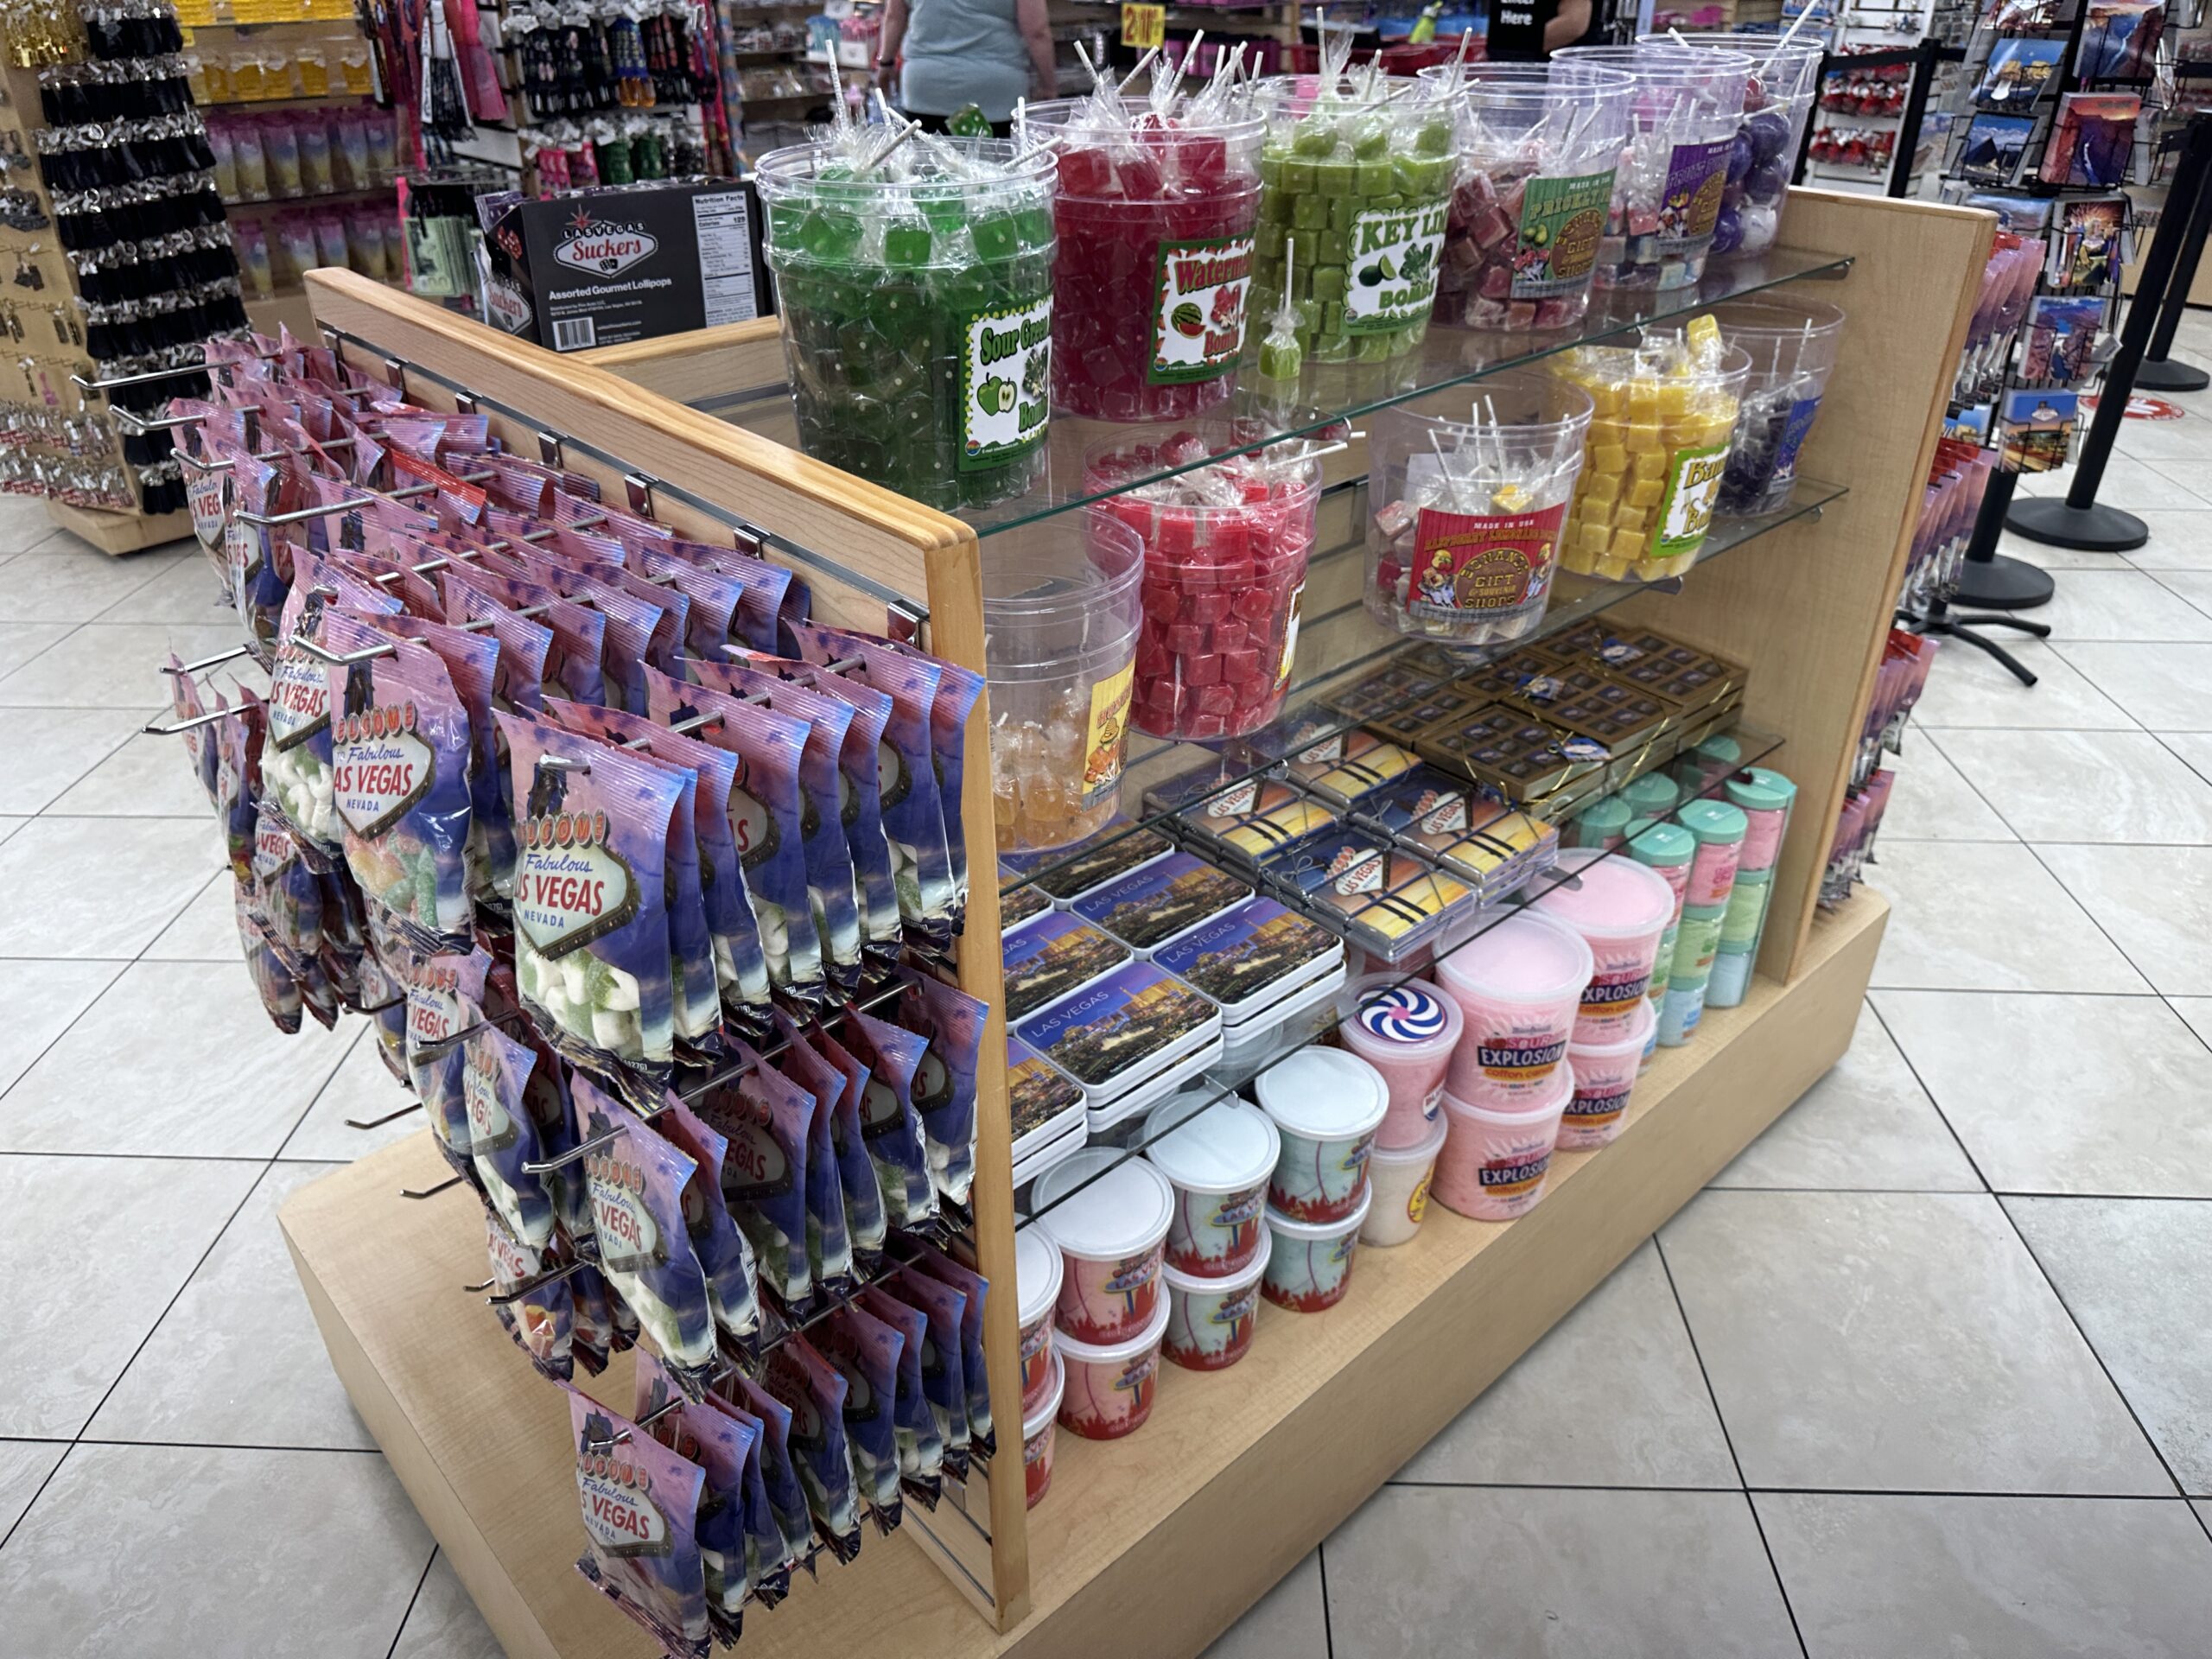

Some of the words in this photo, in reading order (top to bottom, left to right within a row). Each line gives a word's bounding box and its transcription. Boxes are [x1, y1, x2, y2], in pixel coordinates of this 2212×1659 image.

[1500, 10, 1533, 26] Here
[696, 196, 724, 205] Nutrition
[1360, 217, 1419, 256] KEY
[572, 238, 641, 261] Suckers
[549, 287, 592, 301] Assorted
[592, 282, 632, 295] Gourmet
[632, 277, 672, 290] Lollipops
[980, 327, 1020, 366] Sour
[198, 493, 220, 517] VEG
[1519, 519, 1534, 528] USA
[1474, 574, 1515, 588] GIFT
[1464, 595, 1516, 609] SHOPS
[283, 684, 327, 718] VEGAS
[273, 709, 296, 727] NEVADA
[333, 704, 414, 742] ELCOME
[347, 744, 404, 763] Fabulous
[334, 766, 353, 792] AS
[358, 763, 413, 797] VEGAS
[346, 798, 379, 812] NEVADA
[1214, 804, 1230, 817] LAS
[1227, 785, 1255, 805] VEGAS
[1435, 801, 1464, 822] VEGAS
[521, 815, 603, 847] LCOME
[1428, 820, 1445, 834] LAS
[524, 854, 594, 873] Fabulous
[1342, 880, 1359, 893] LAS
[1351, 859, 1382, 881] VEGAS
[536, 874, 605, 917] VEGAS
[1085, 895, 1113, 912] LAS
[1112, 875, 1154, 899] VEGAS
[524, 909, 565, 929] NEVADA
[1003, 938, 1027, 956] GAS
[1166, 945, 1194, 963] LAS
[1192, 922, 1236, 947] VEGAS
[1582, 978, 1646, 1001] XPLOSION
[412, 1004, 449, 1040] VEGAS
[1032, 1017, 1062, 1039] LAS
[1061, 991, 1109, 1020] VEGAS
[1480, 1043, 1565, 1066] EXPLOSION
[1484, 1068, 1523, 1078] cotton
[1567, 1093, 1628, 1113] XPLOSION
[726, 1139, 766, 1181] EGAS
[582, 1477, 639, 1507] Fabulous
[585, 1514, 616, 1539] NEVADA
[592, 1493, 650, 1541] VEGAS
